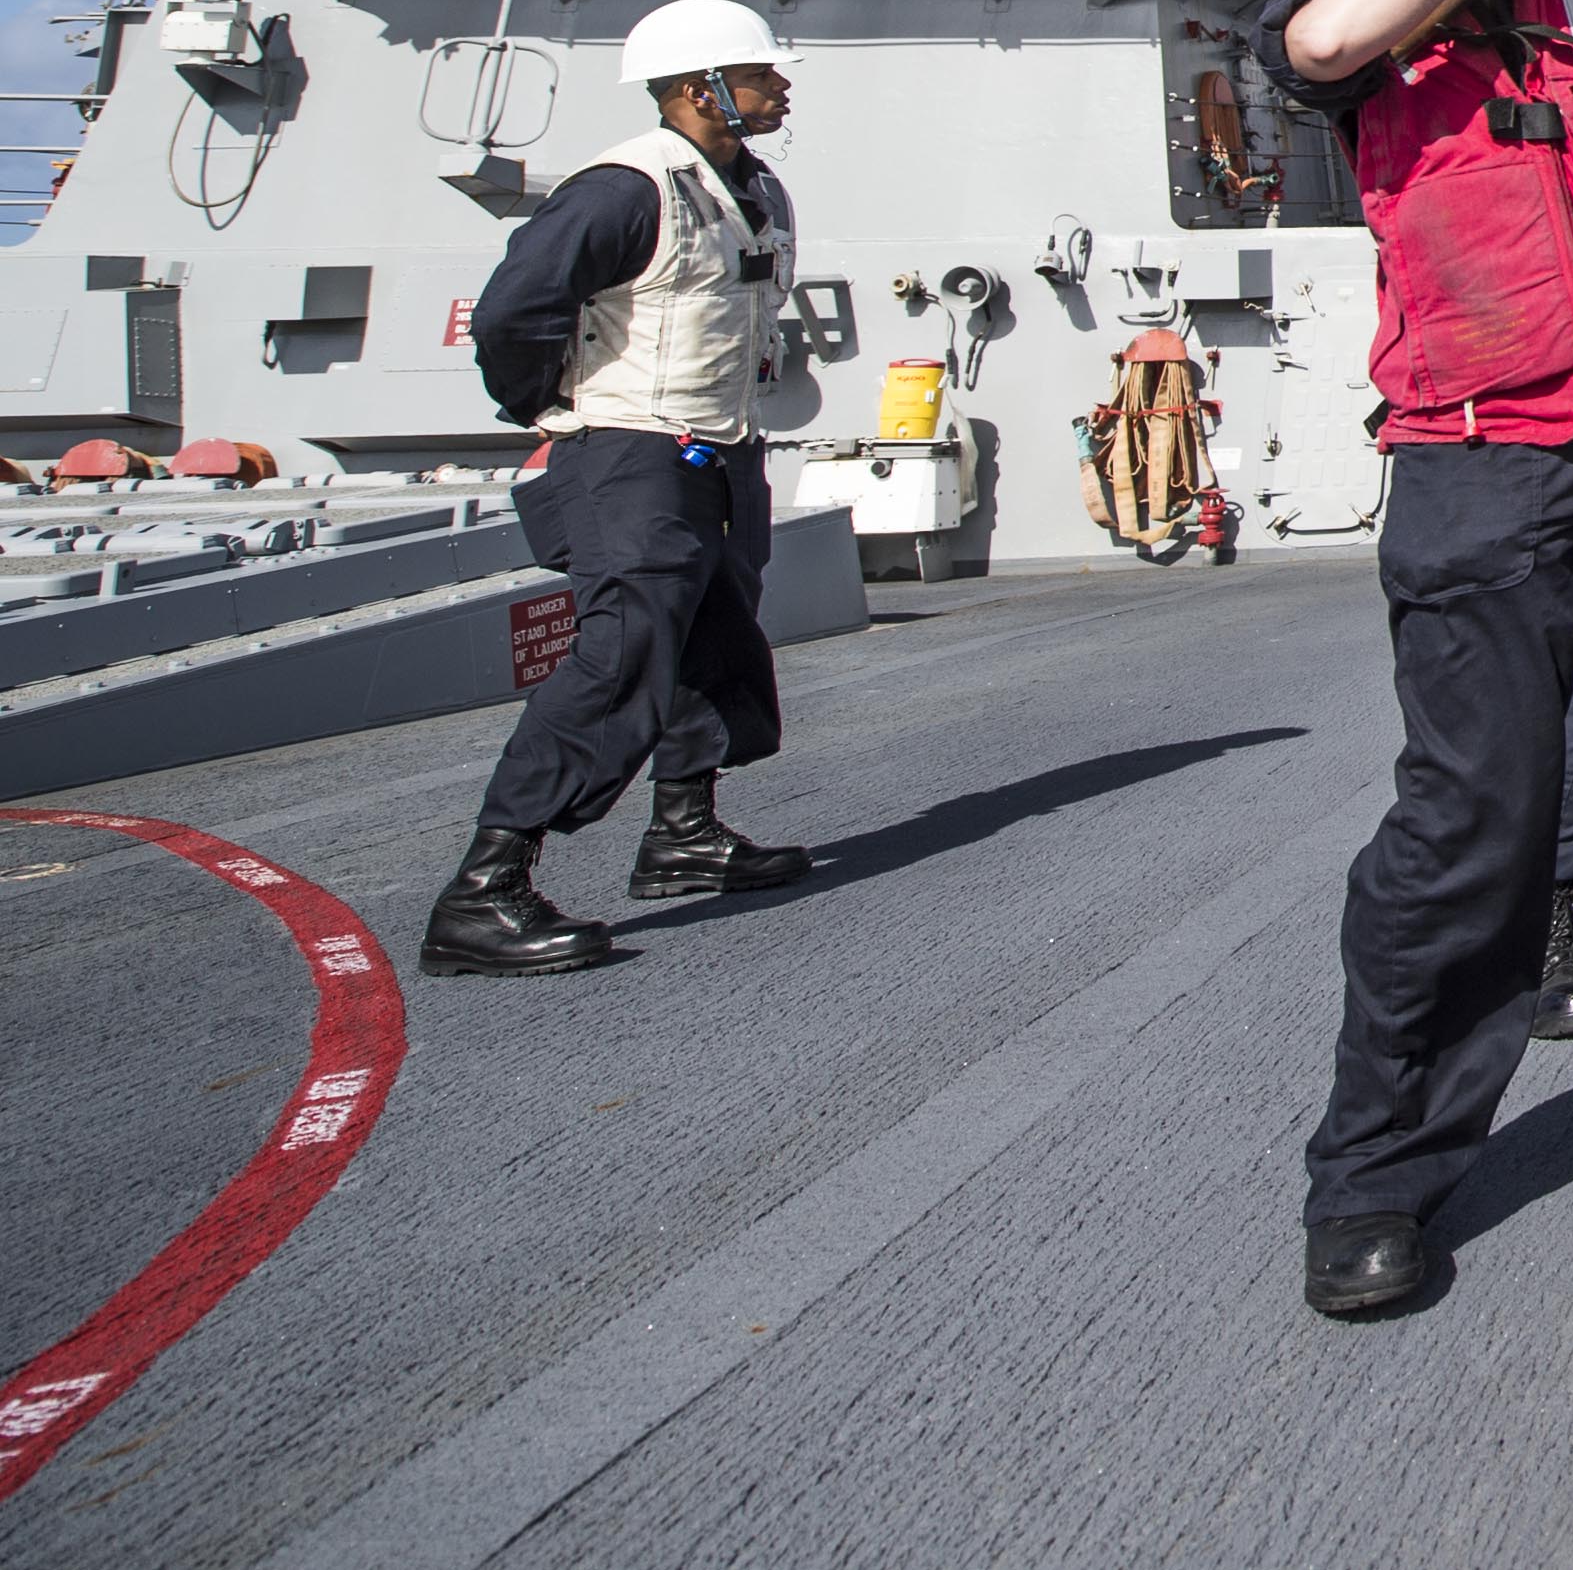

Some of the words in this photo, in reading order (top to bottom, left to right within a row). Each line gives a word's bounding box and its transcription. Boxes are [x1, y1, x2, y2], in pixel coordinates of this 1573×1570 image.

[527, 596, 567, 620] DANGER
[513, 624, 547, 646] STAND
[551, 616, 577, 635] CLEA
[515, 647, 529, 664] OF
[533, 632, 580, 659] LAUNCH
[523, 661, 551, 682] DECK
